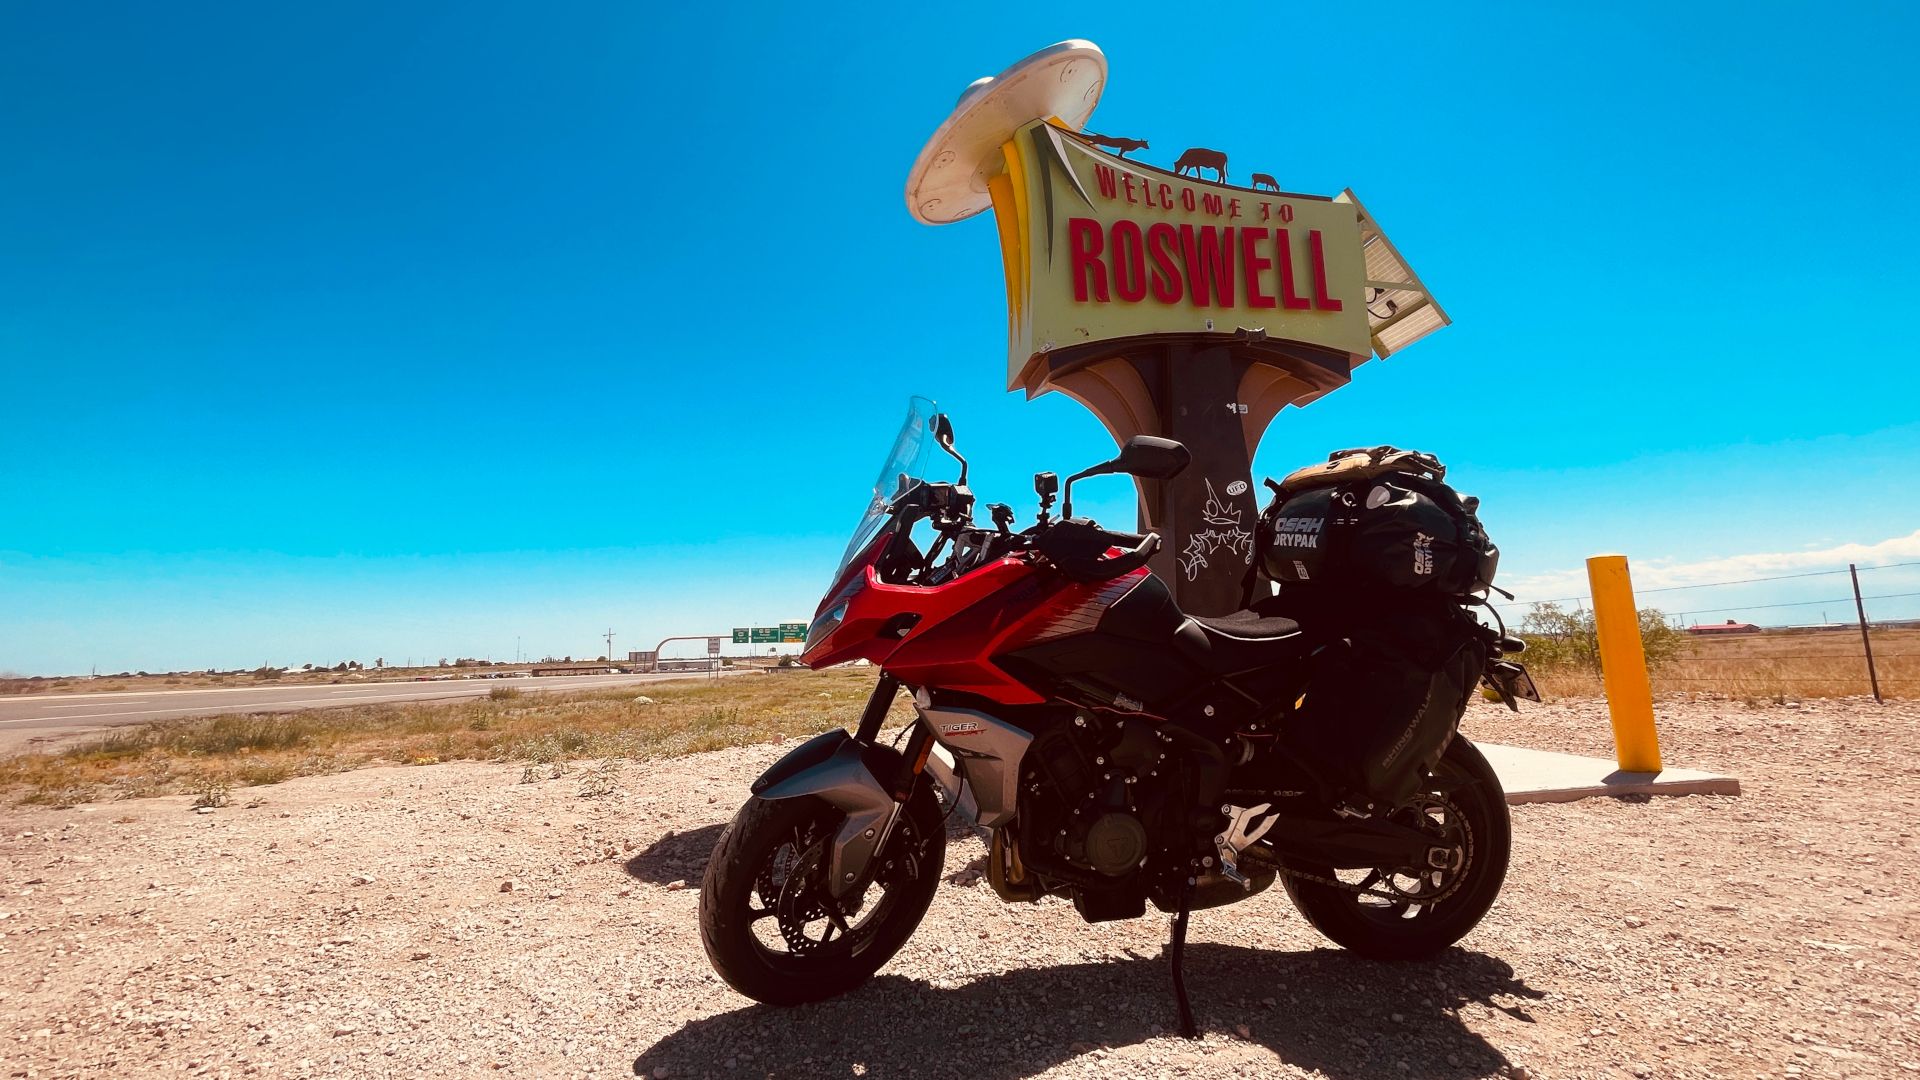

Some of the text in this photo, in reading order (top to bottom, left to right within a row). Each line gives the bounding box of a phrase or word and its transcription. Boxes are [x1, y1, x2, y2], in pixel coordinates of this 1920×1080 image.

[1094, 162, 1295, 223] WELCOME TO
[1068, 217, 1343, 312] ROSWELL
[1274, 517, 1325, 533] OSAH
[1273, 533, 1318, 548] DRYPAK
[940, 722, 979, 733] TIGER
